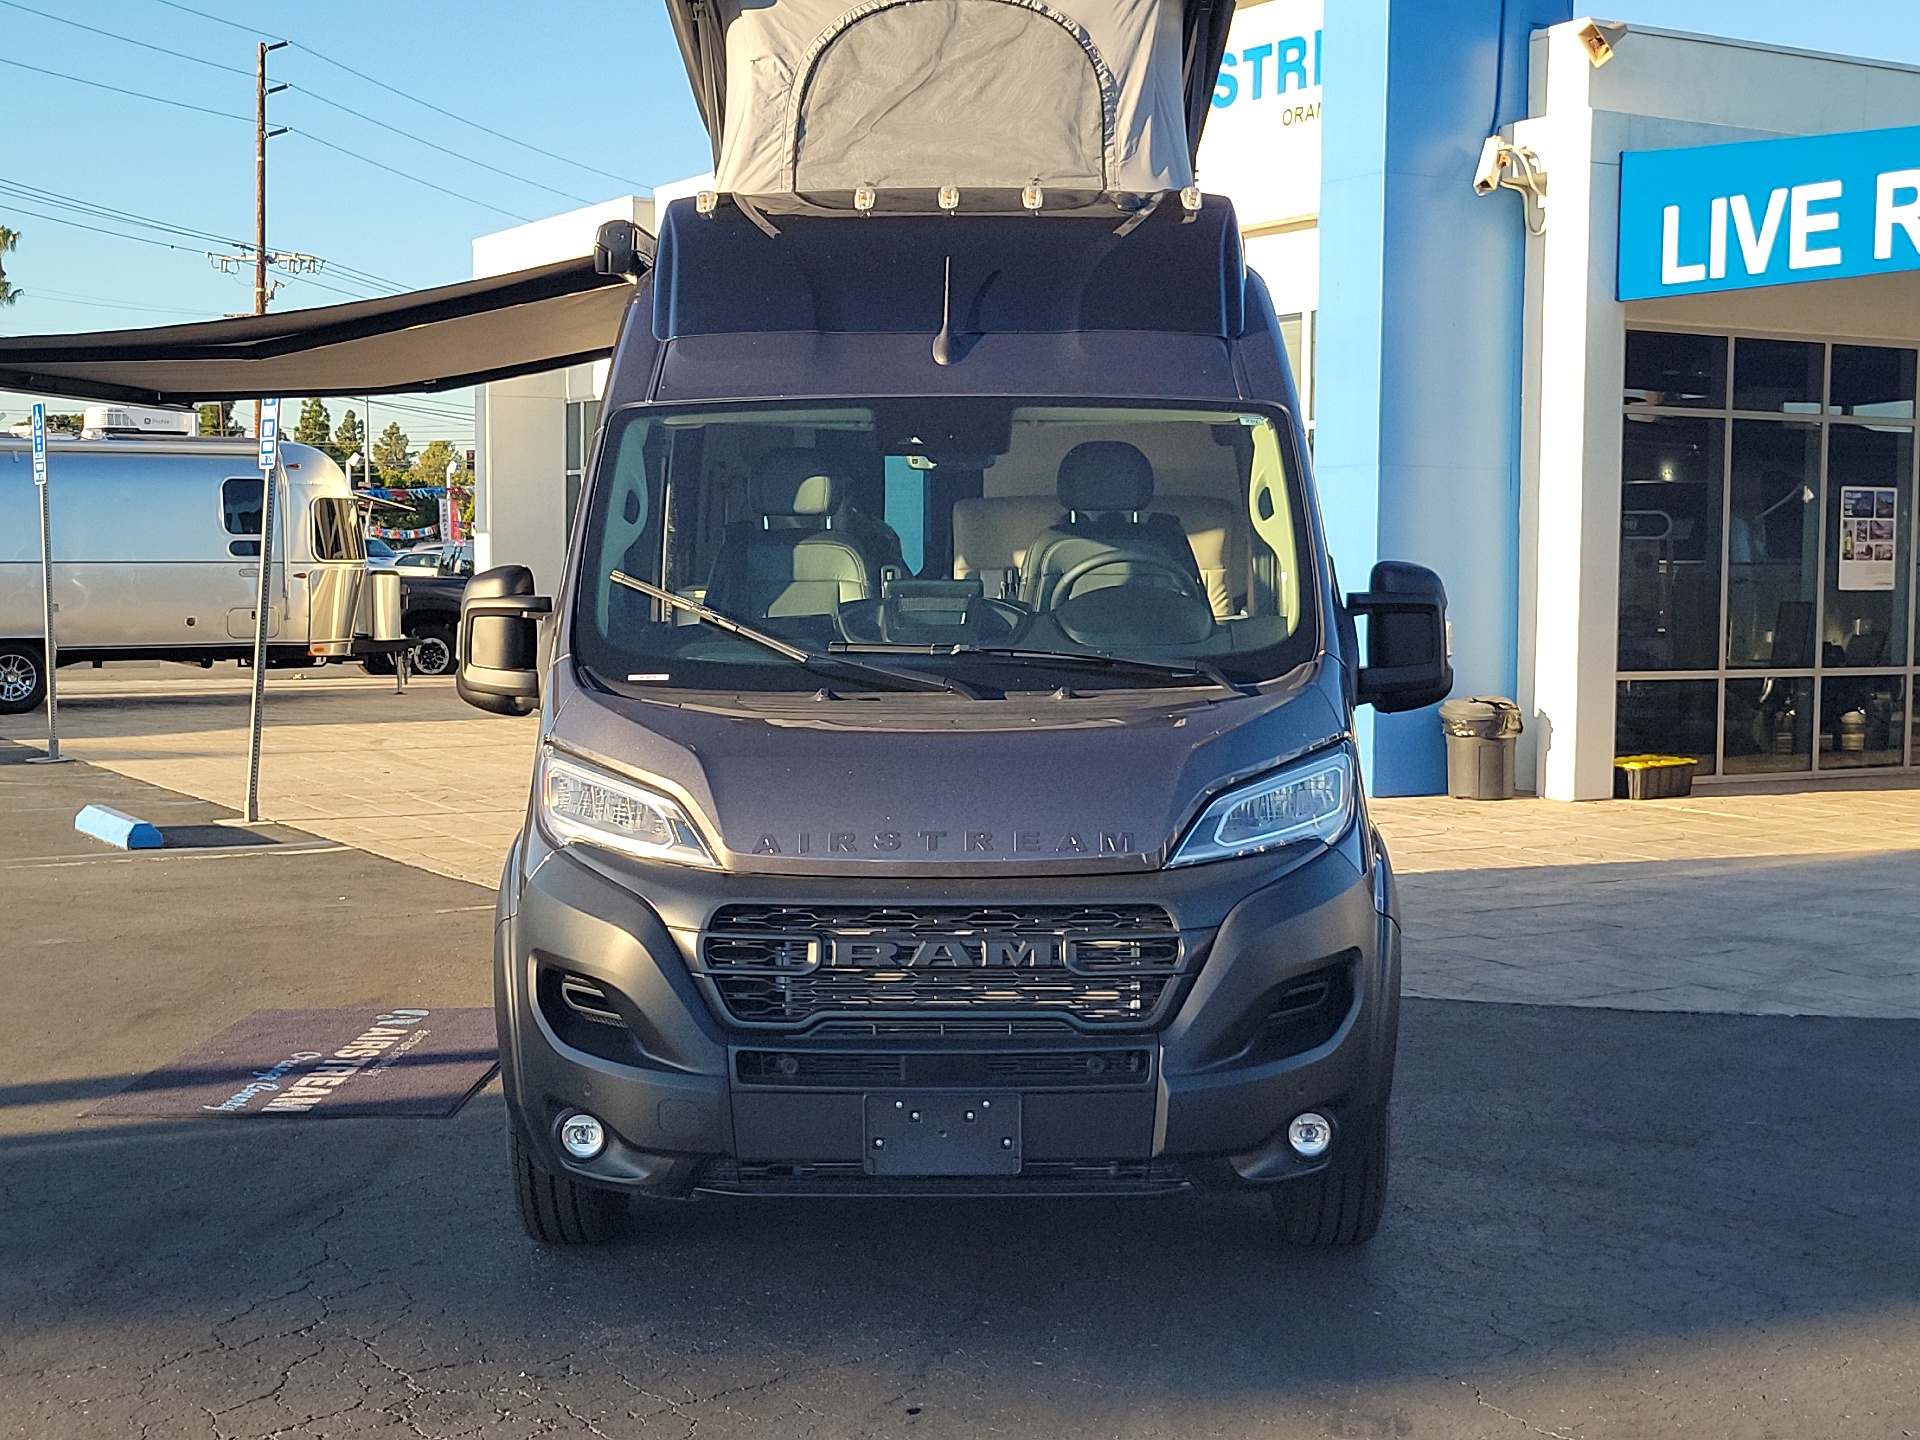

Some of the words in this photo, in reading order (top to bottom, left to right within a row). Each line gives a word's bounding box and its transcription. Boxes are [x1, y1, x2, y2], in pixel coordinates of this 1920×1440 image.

[1211, 29, 1322, 109] STR
[1661, 179, 1843, 285] LIVE
[751, 831, 1135, 854] AIRSTREAM
[832, 940, 1053, 966] RAM
[261, 1026, 409, 1112] AIRSTREAM
